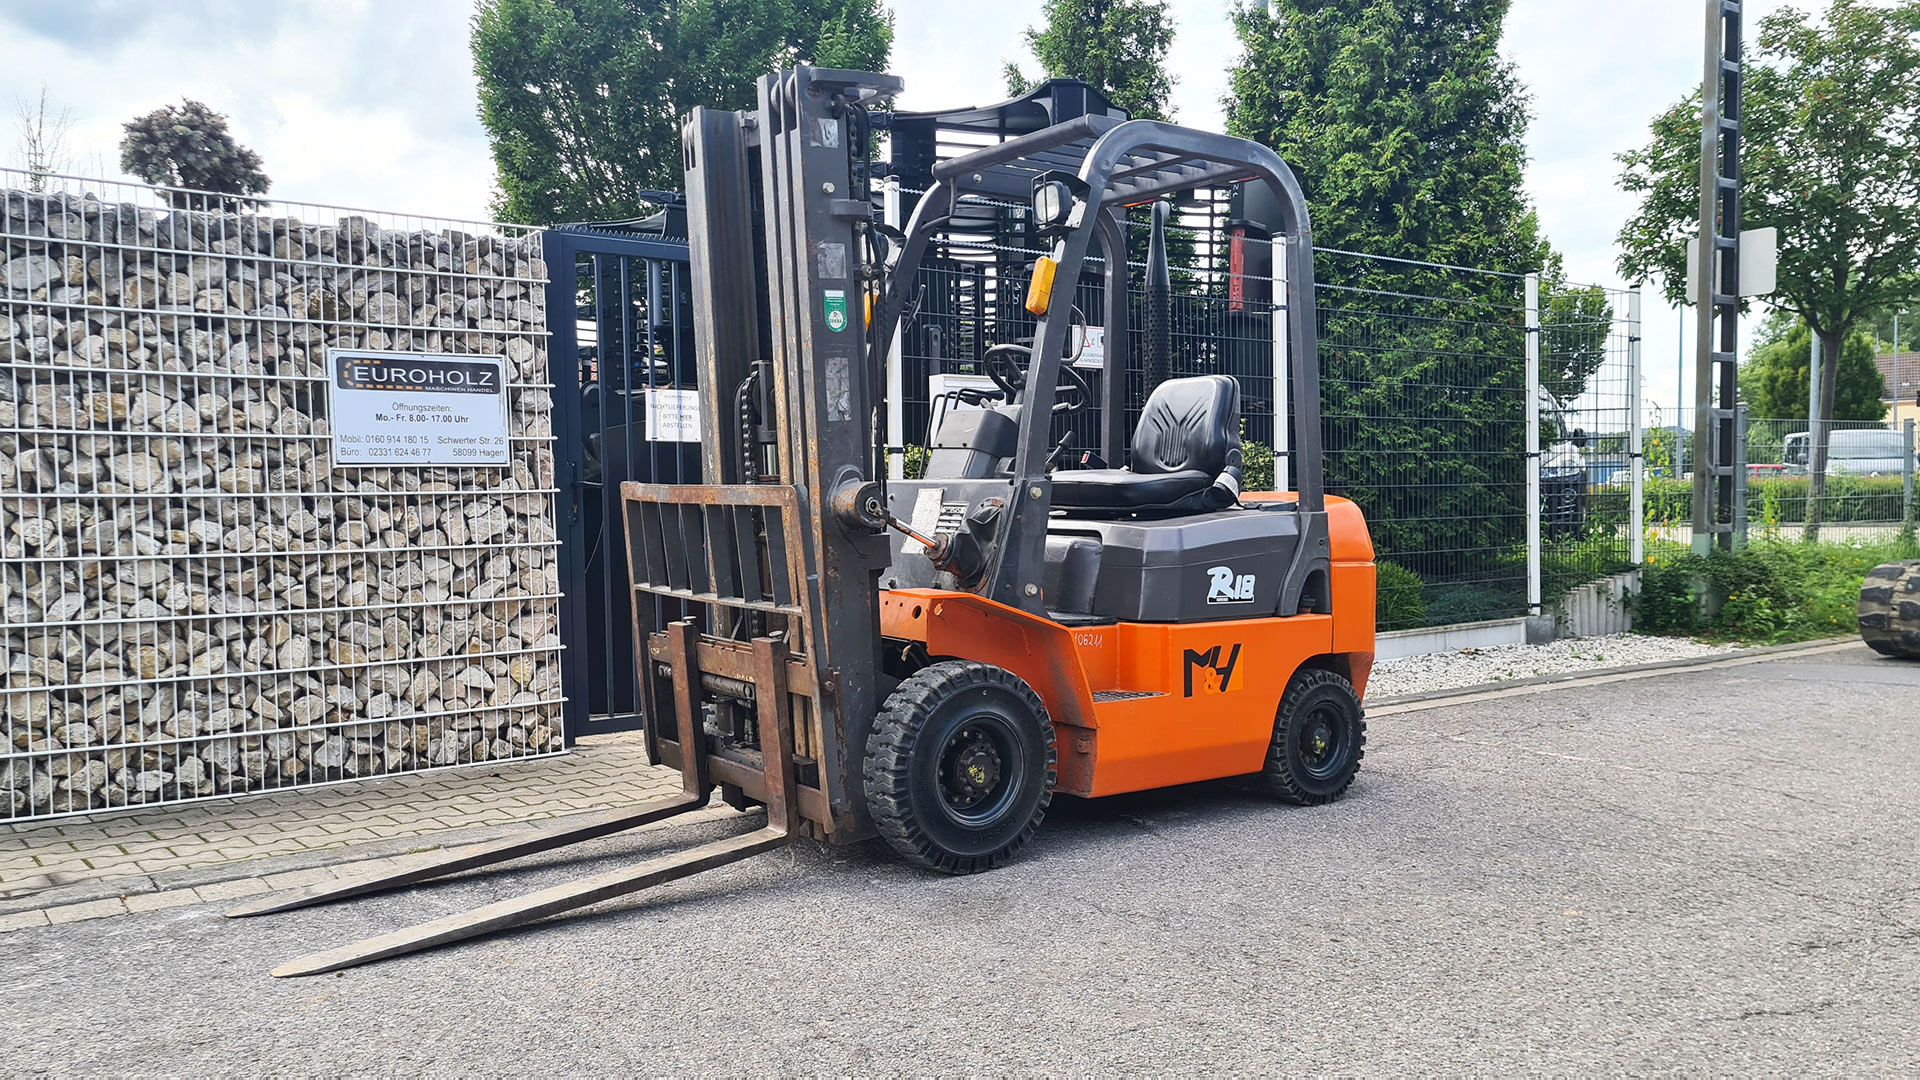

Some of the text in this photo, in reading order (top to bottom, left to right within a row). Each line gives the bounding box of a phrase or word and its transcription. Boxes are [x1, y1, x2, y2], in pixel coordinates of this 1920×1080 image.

[353, 366, 494, 386] EUROHOLZ
[396, 414, 407, 422] Fr.
[431, 415, 453, 423] 17.00
[454, 415, 469, 423] Uhr
[340, 434, 429, 444] Mobil: 0160 914 180 15
[437, 436, 504, 445] Schwerter Str. 26
[340, 447, 432, 456] Büro: 02331 624 46 77
[452, 448, 505, 458] 58099 Hagen
[1206, 566, 1256, 600] R18
